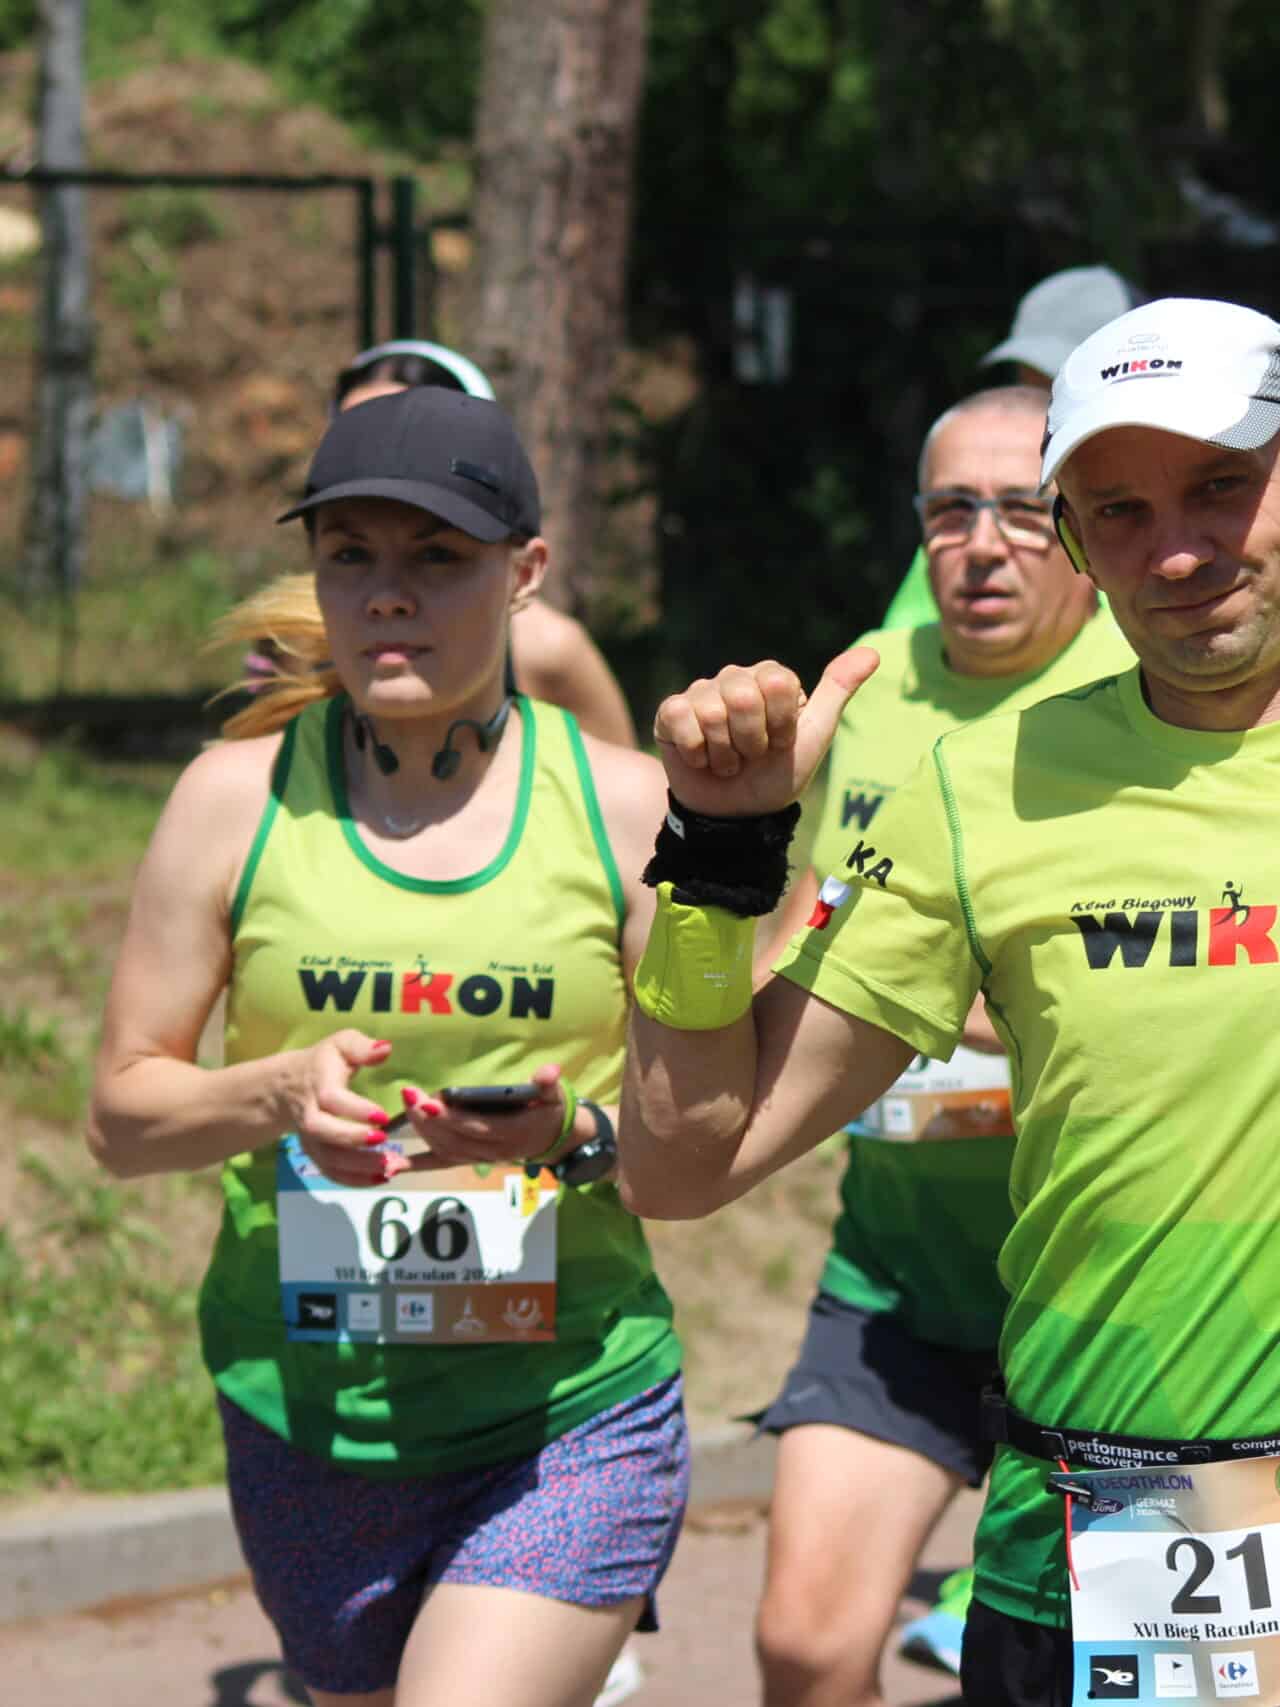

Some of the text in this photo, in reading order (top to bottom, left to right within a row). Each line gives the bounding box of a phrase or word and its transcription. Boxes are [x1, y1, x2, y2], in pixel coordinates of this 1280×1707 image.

[1100, 358, 1183, 380] WIKON
[1122, 895, 1197, 912] Biegowy
[297, 969, 555, 1021] WIKON
[368, 1196, 470, 1262] 66
[1068, 1438, 1179, 1462] performance
[1083, 1452, 1143, 1469] recovery
[1091, 1500, 1119, 1513] Ford
[1165, 1532, 1272, 1615] 21
[1133, 1622, 1159, 1638] XVI
[1164, 1622, 1200, 1641] Bieg
[1204, 1619, 1279, 1639] Raculan
